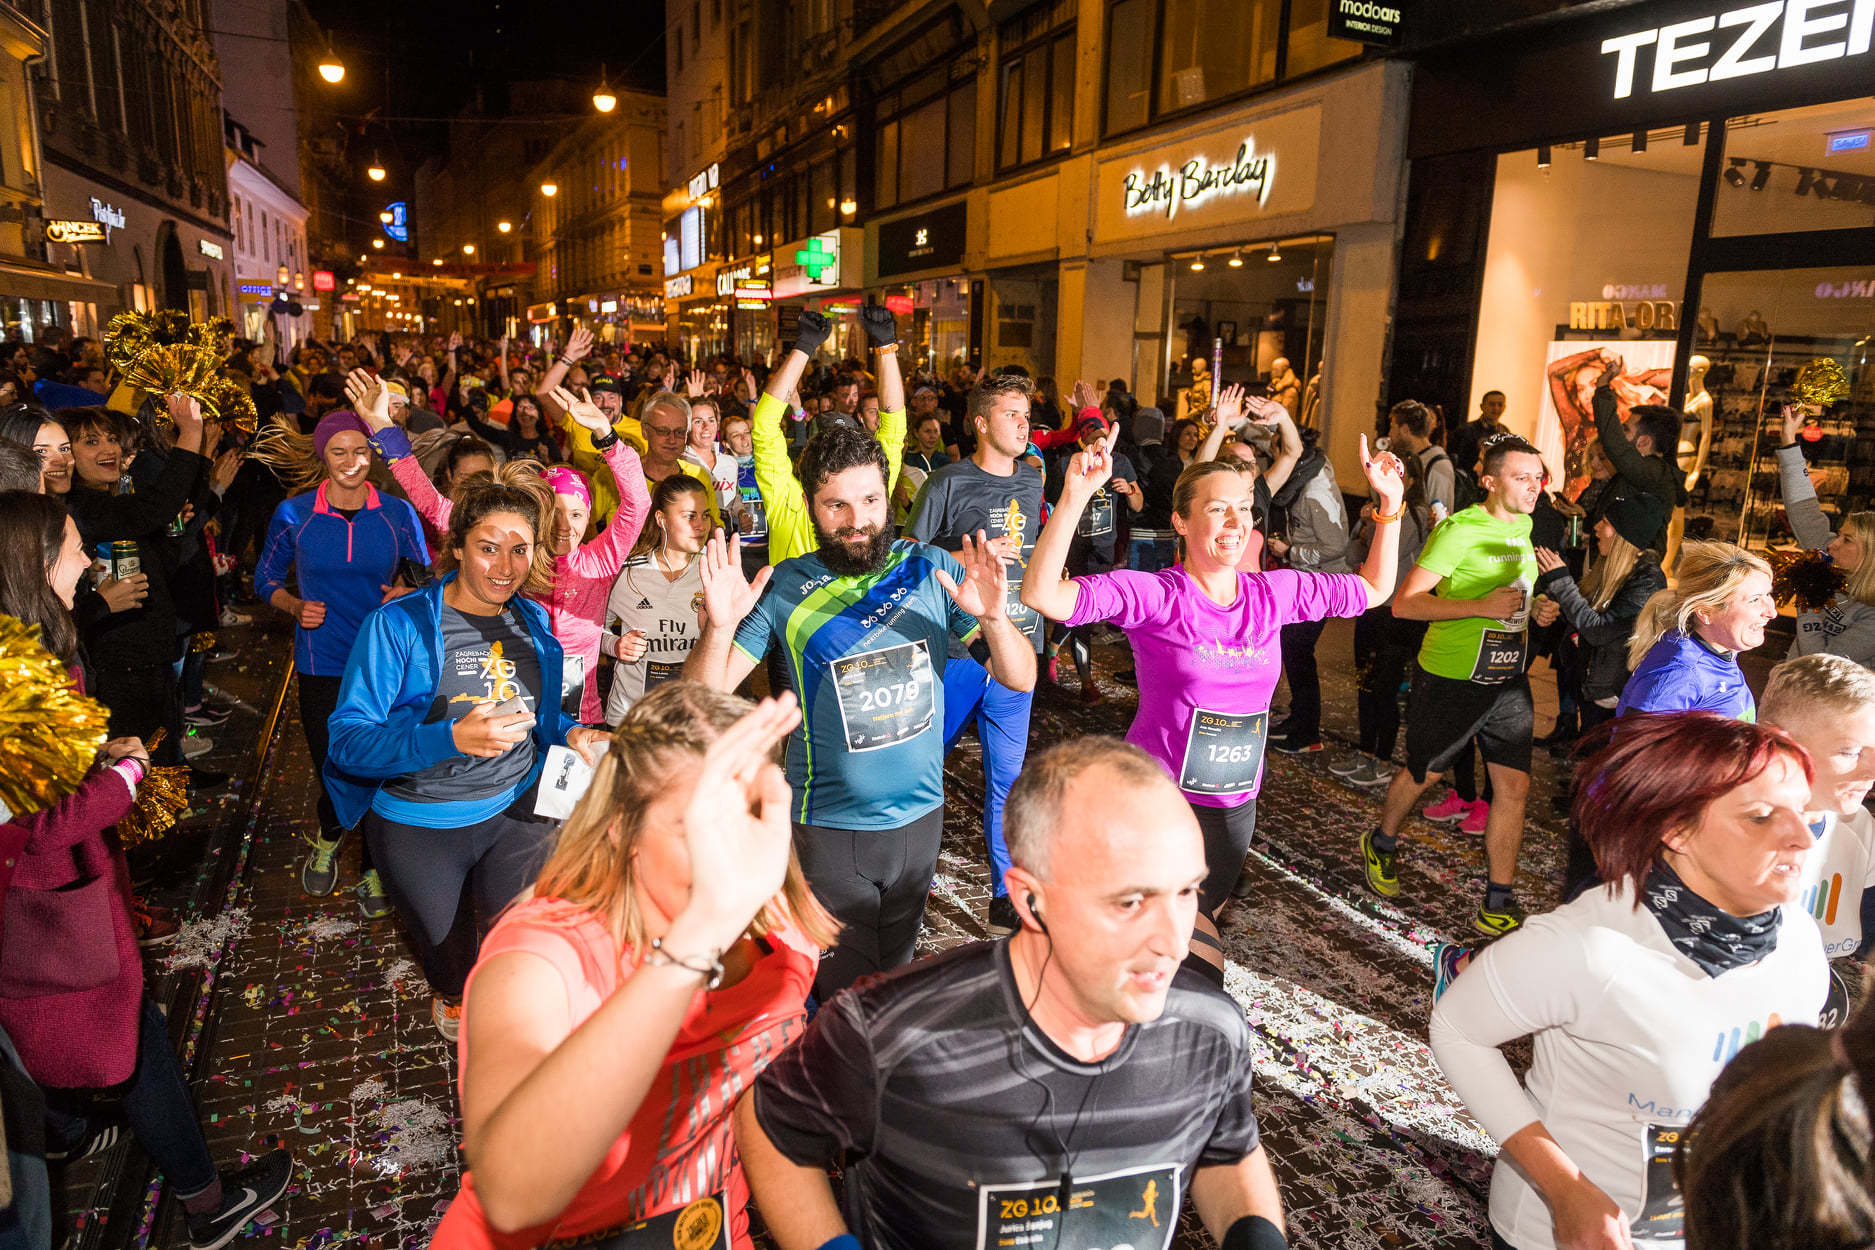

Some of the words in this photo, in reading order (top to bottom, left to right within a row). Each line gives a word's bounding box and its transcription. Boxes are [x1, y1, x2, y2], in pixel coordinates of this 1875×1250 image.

[1339, 0, 1401, 23] modoars
[1345, 19, 1371, 32] INTERIOR
[1371, 24, 1393, 35] DESIGN
[1123, 171, 1174, 218] Betty
[1180, 143, 1268, 202] Barclay
[48, 220, 102, 237] VINCEK
[1569, 301, 1627, 330] RITA
[659, 619, 686, 634] Fly
[863, 624, 888, 648] nextbike
[886, 608, 907, 629] running
[647, 634, 698, 652] mirat
[1489, 650, 1520, 664] 1202
[1208, 744, 1252, 763] 1263
